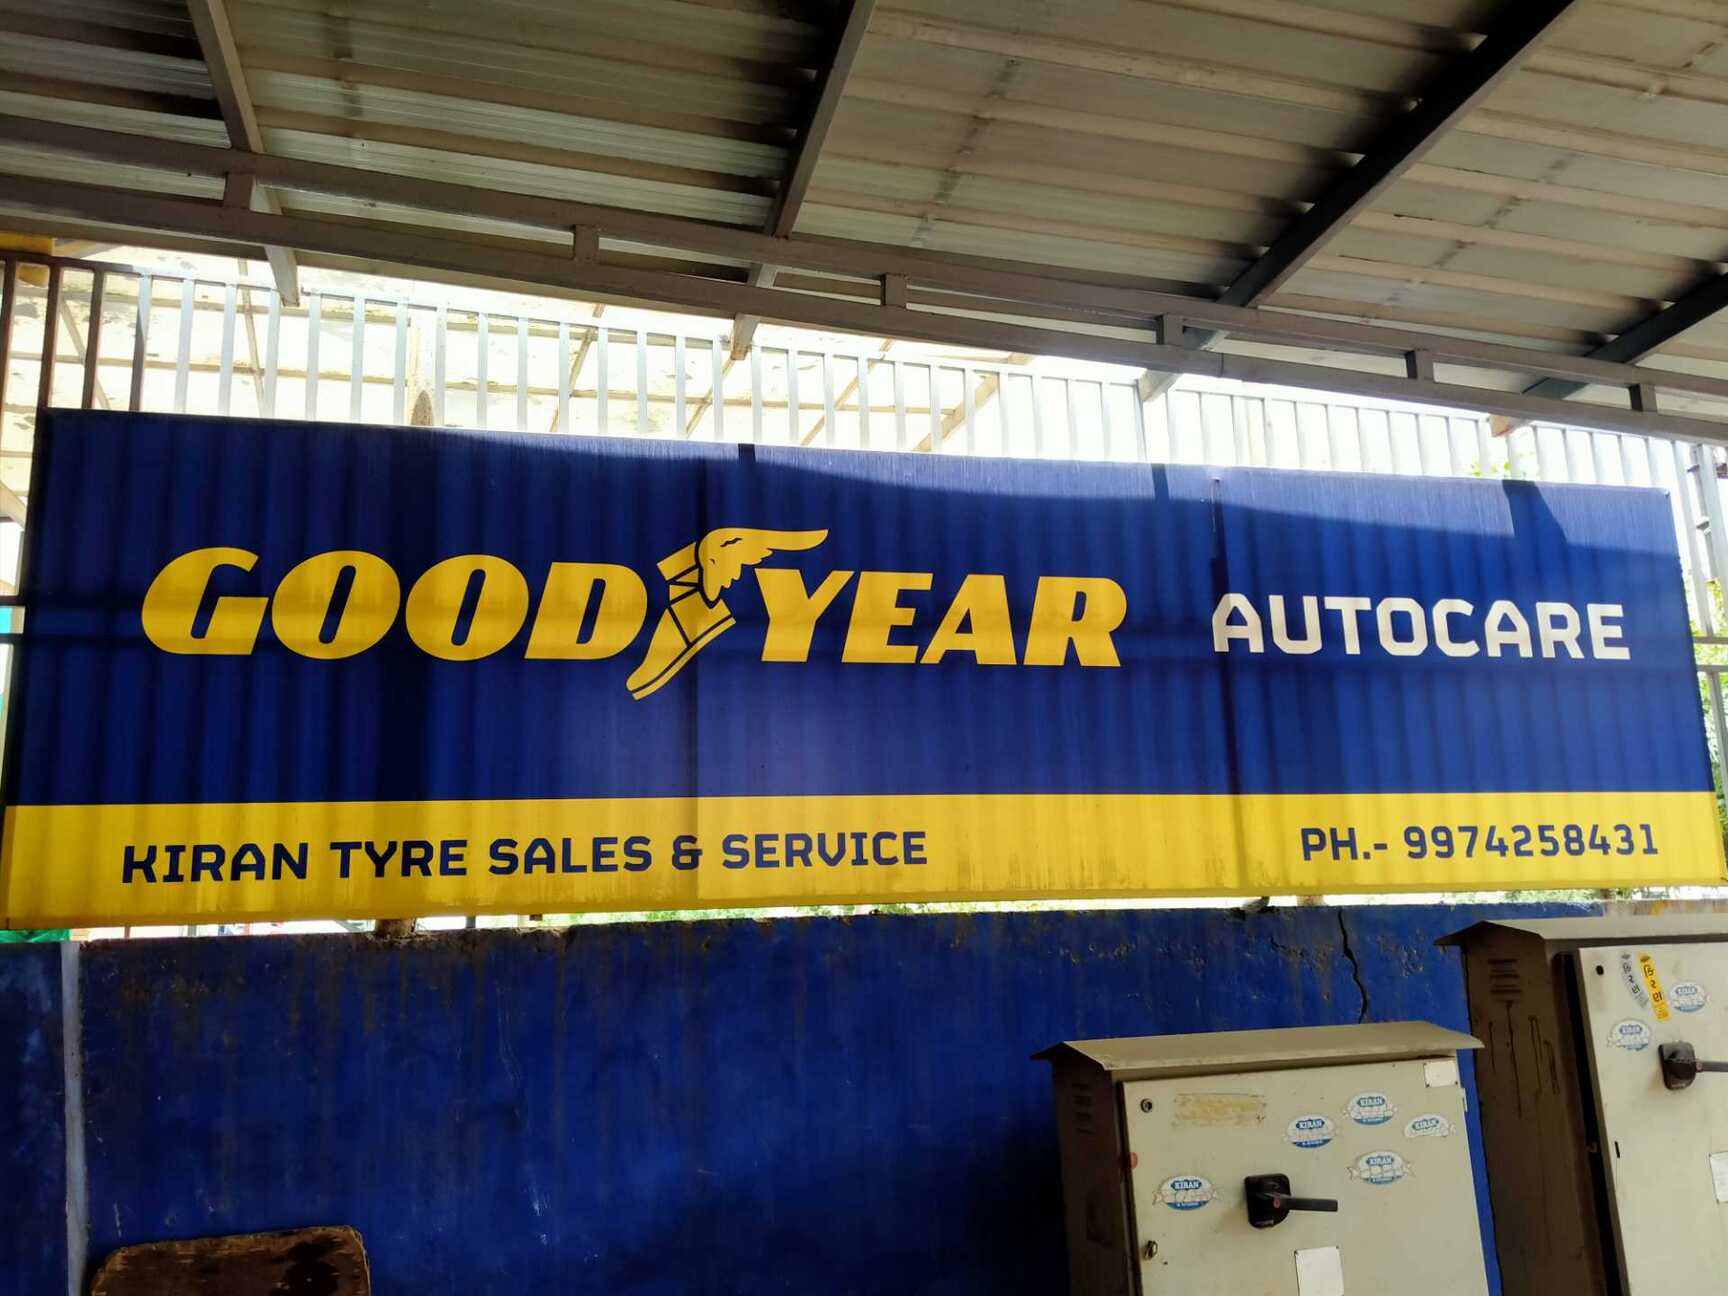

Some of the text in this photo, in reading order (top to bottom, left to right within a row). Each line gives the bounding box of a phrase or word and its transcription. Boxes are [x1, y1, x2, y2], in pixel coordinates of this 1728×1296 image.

[1211, 592, 1632, 661] AUTOCARE
[121, 831, 928, 884] KIRAN TYRE SALES & SERVICE
[1301, 824, 1658, 861] PH.- 9974258431
